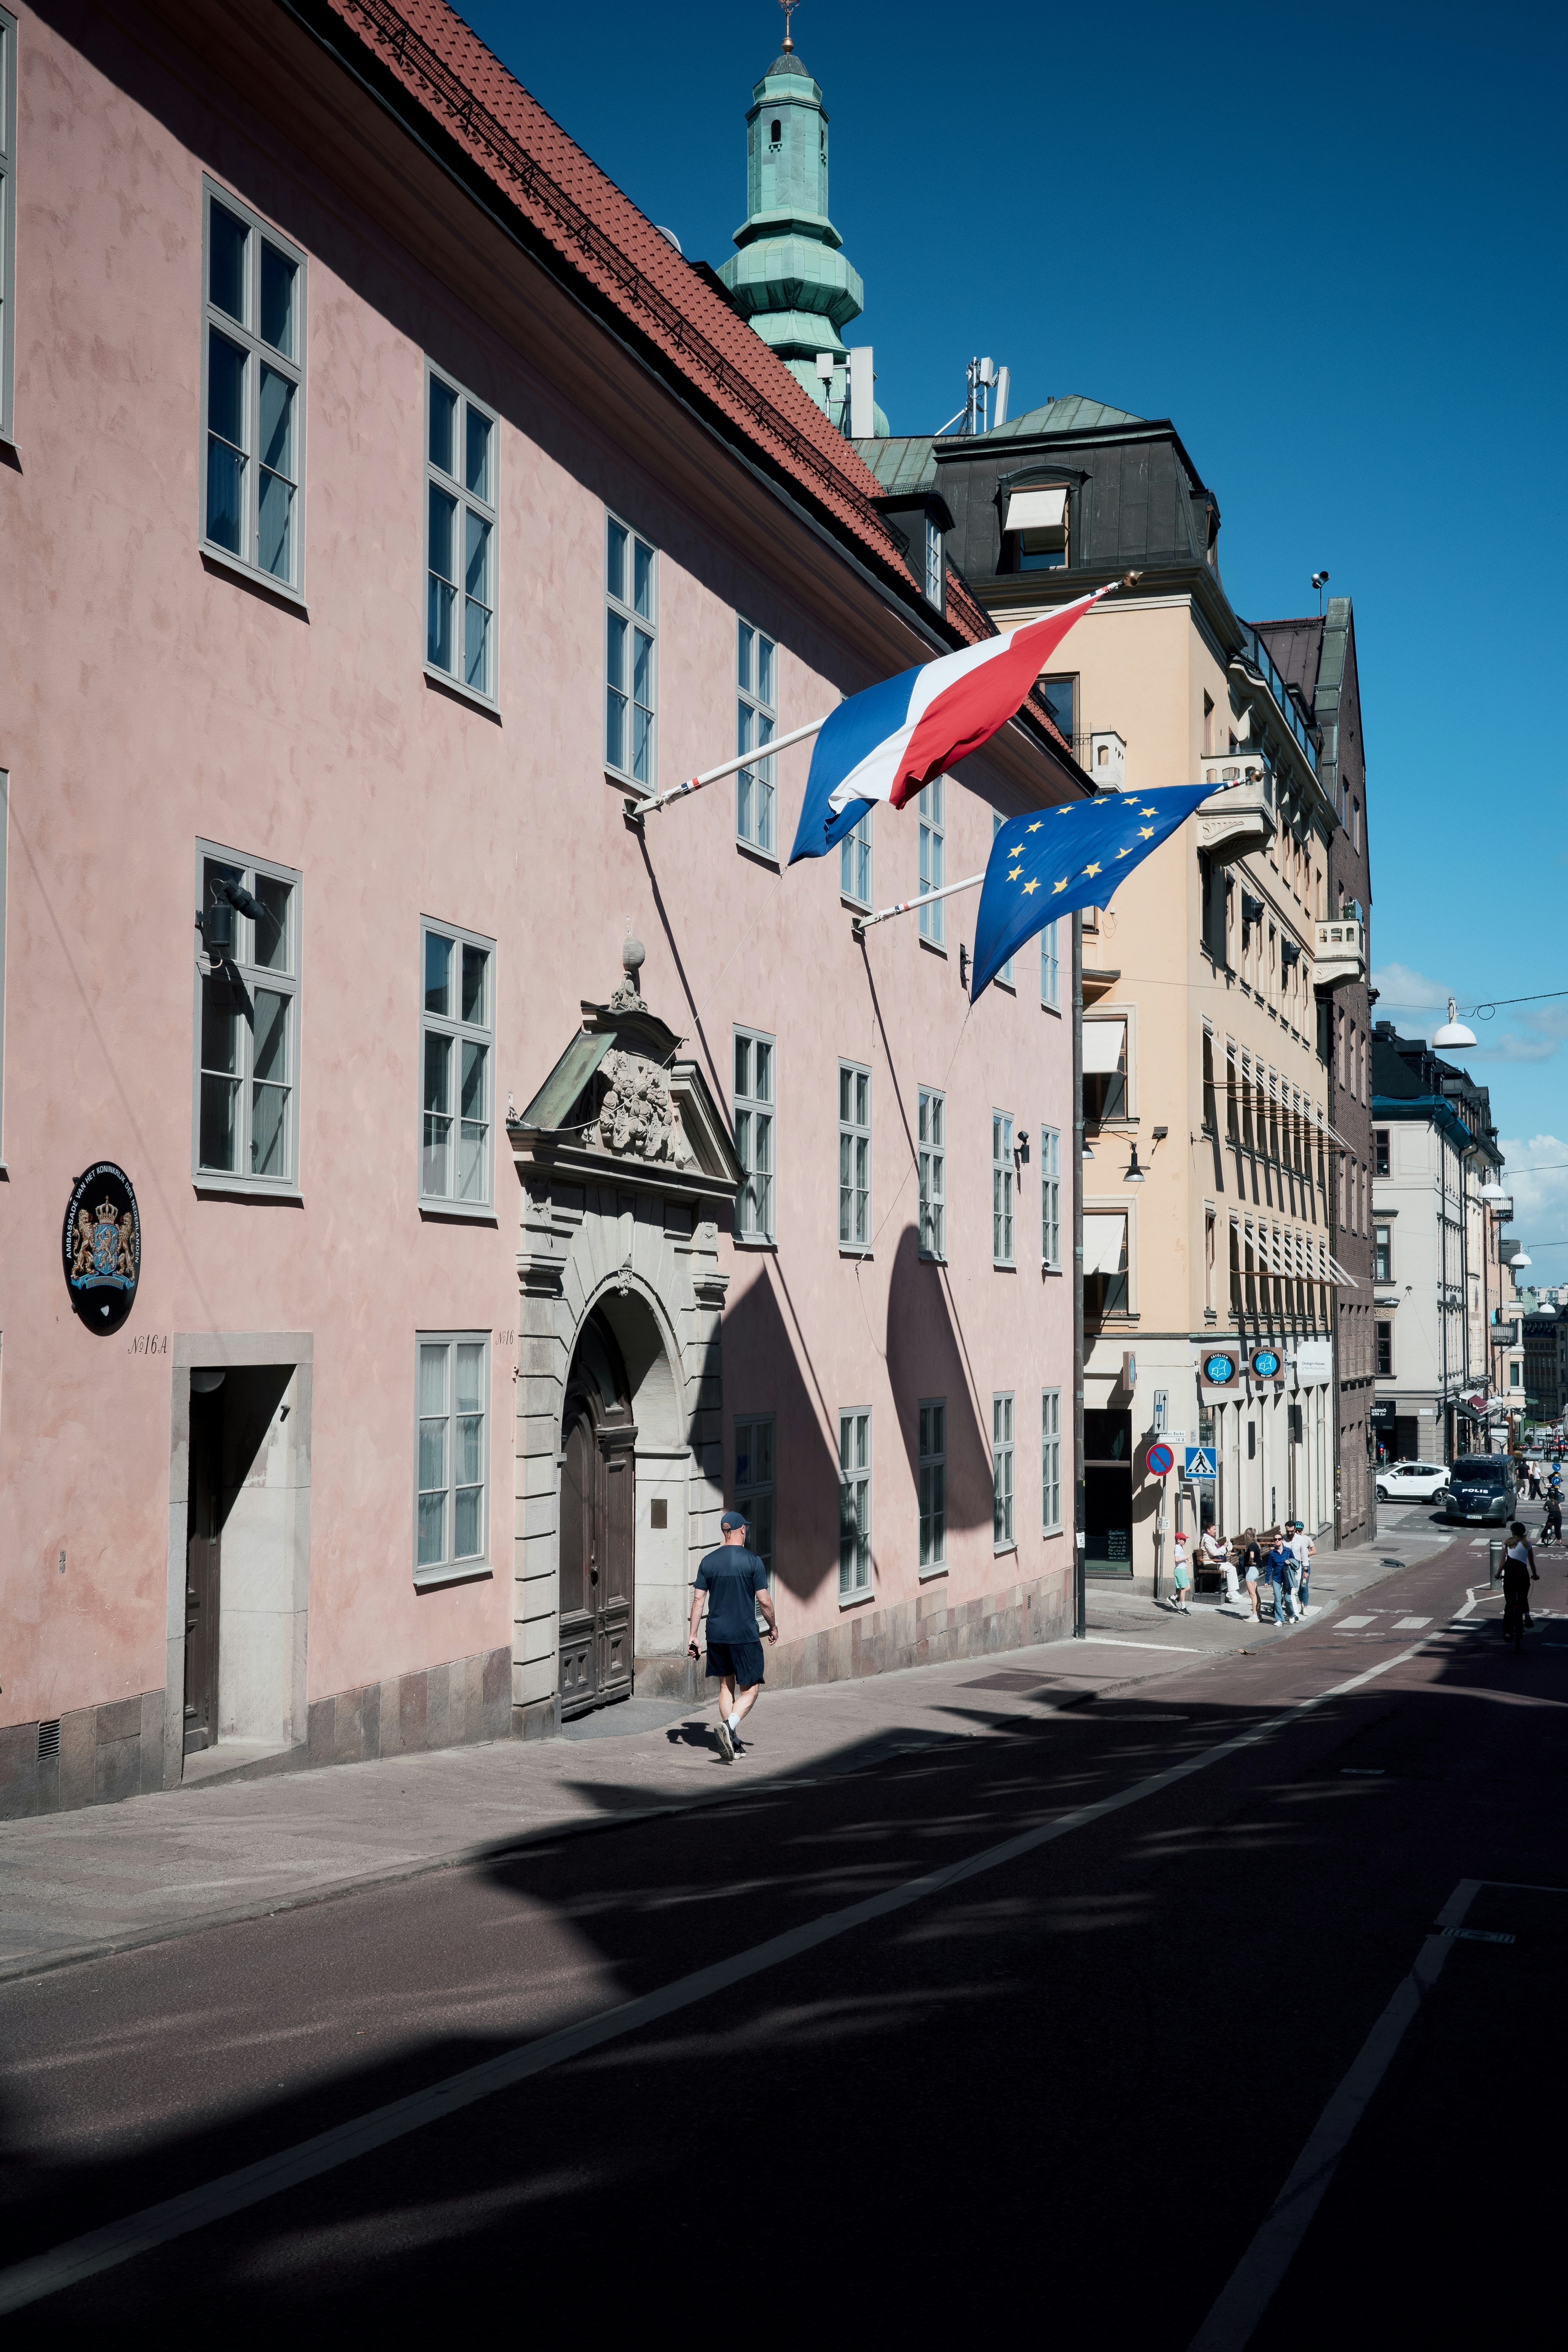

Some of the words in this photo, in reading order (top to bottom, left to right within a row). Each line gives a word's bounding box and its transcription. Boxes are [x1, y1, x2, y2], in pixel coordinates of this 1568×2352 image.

[66, 1200, 78, 1258] AMBASSADE
[75, 1182, 86, 1198] VAN
[85, 1170, 95, 1184] HET
[96, 1165, 125, 1183] KONINKRIJK
[131, 1199, 139, 1263] NEDERLANDEN
